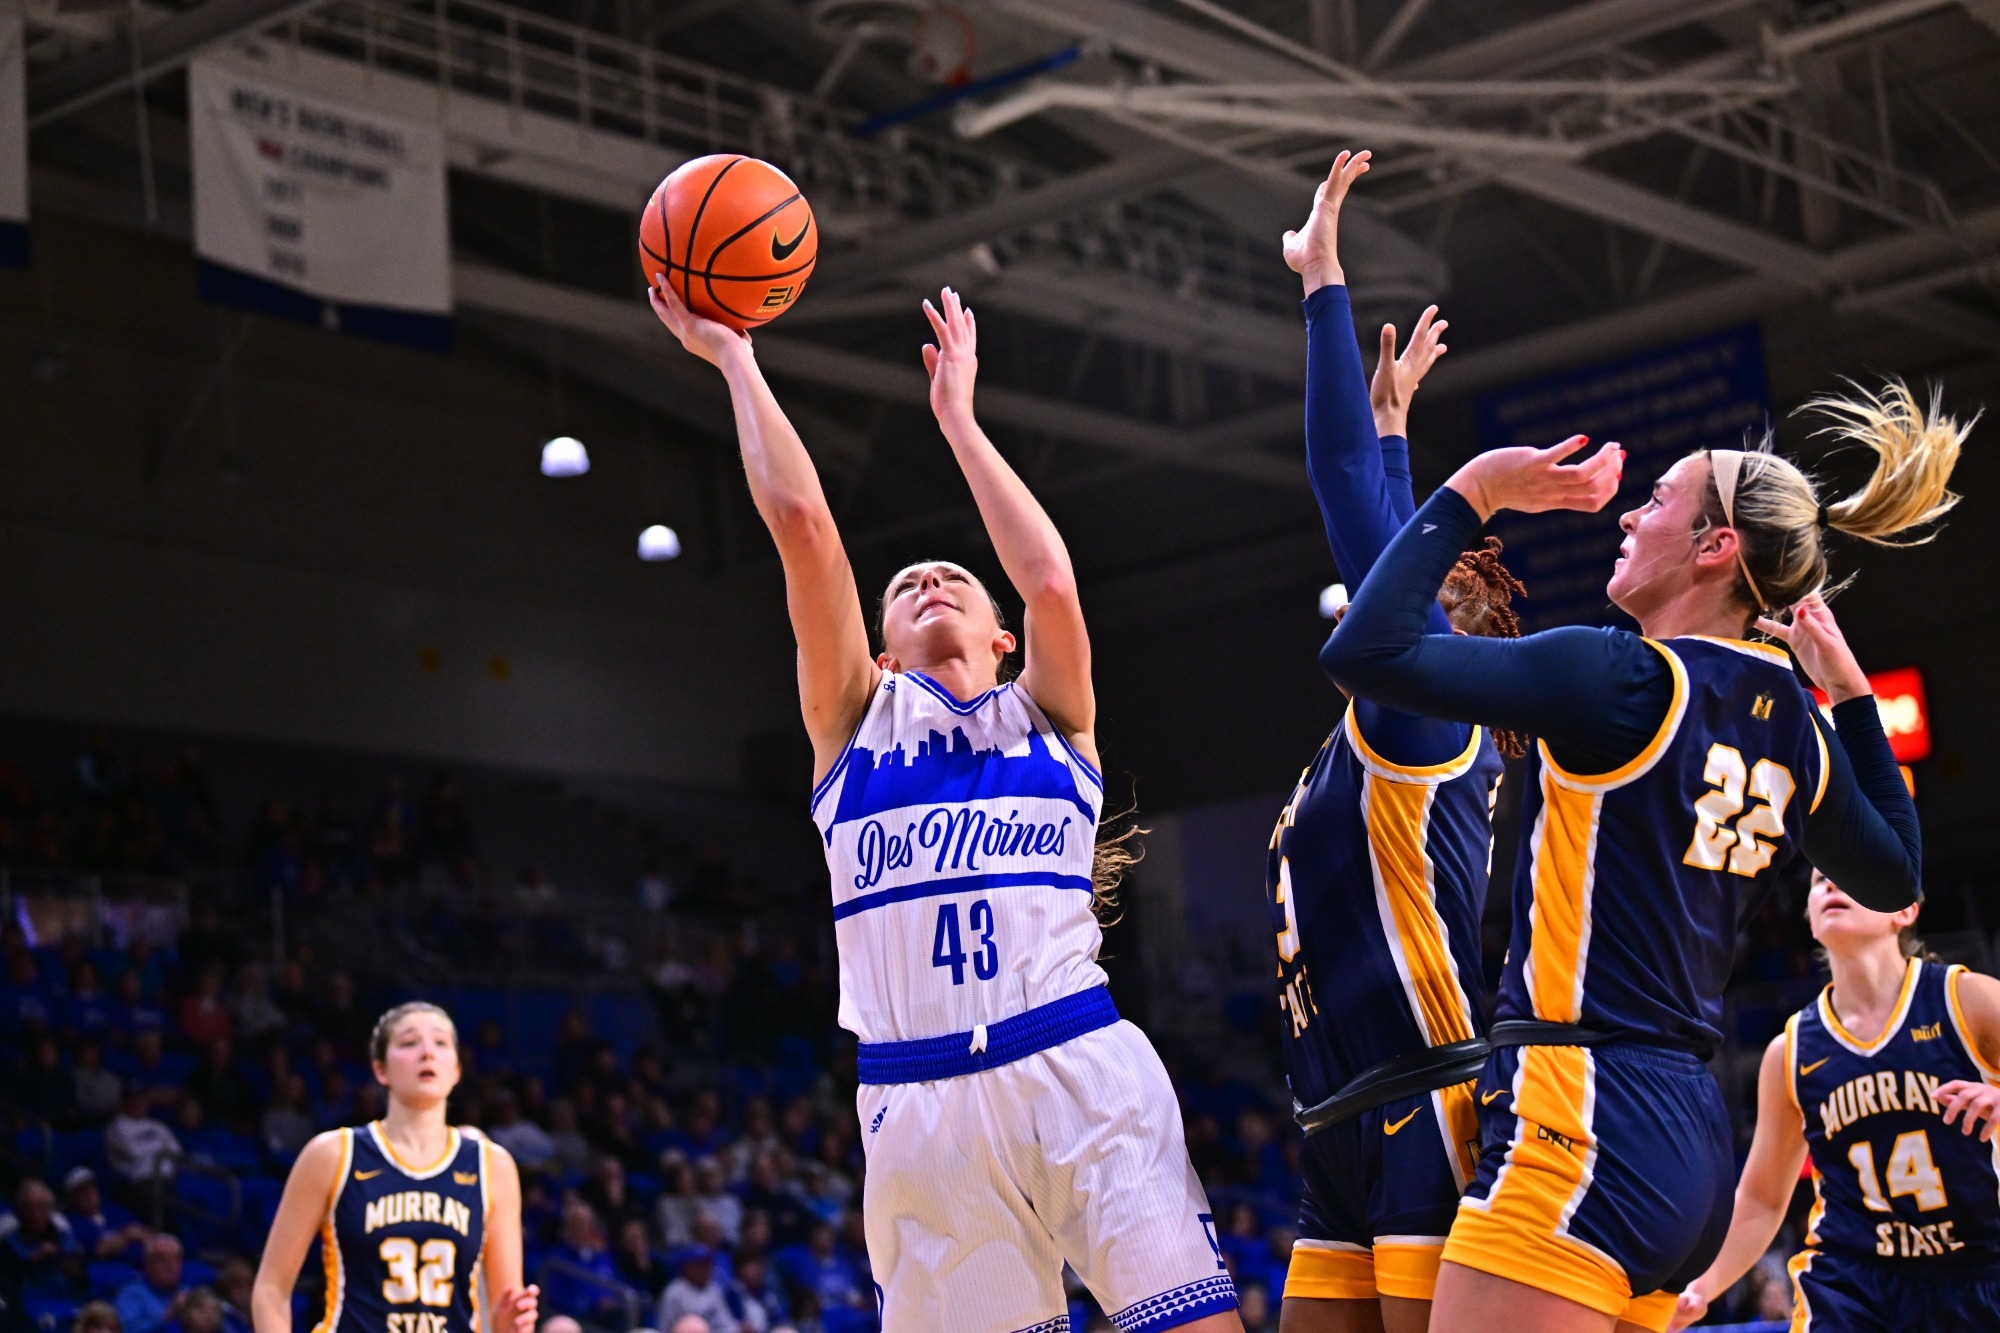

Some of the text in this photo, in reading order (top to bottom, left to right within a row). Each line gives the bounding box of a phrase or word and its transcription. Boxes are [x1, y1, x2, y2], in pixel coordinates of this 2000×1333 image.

[854, 807, 1072, 890] Des Moines
[1683, 743, 1796, 878] 22
[931, 899, 999, 985] 43
[1820, 1071, 1941, 1140] MURRAY
[1848, 1130, 1947, 1212] 14
[364, 1191, 470, 1237] MURRAY
[1876, 1221, 1965, 1257] STATE
[379, 1237, 456, 1307] 32
